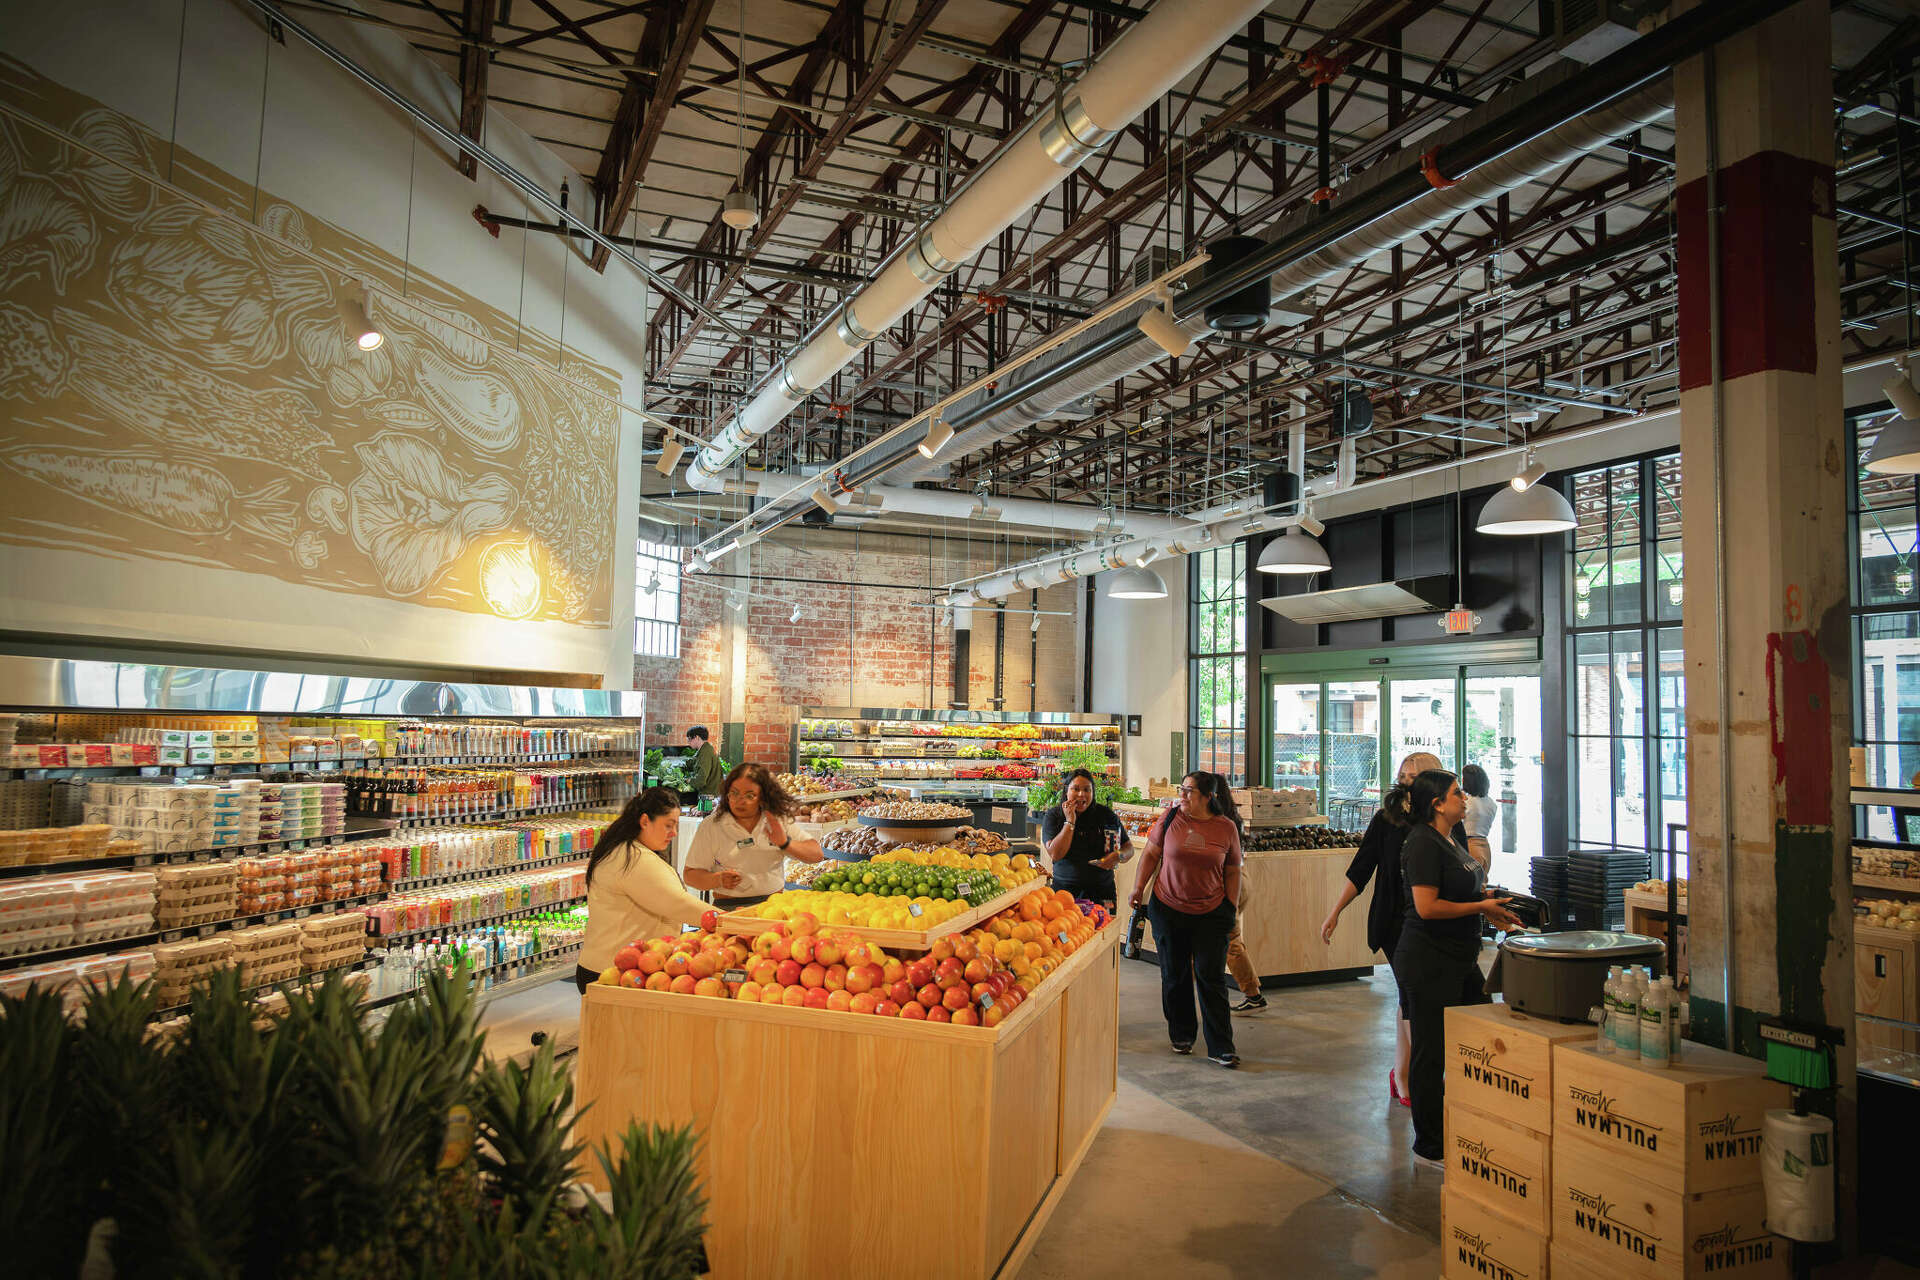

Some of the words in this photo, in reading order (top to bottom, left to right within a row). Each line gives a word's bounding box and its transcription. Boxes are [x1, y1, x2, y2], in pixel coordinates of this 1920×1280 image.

[1449, 612, 1471, 632] EXIT
[1464, 1063, 1529, 1099] PULLMAN
[1576, 1108, 1657, 1152] PULLMAN
[1705, 1136, 1763, 1160] ULLMAN
[1462, 1155, 1527, 1198] PULLMAN
[1576, 1210, 1656, 1261] PULLMAN
[1704, 1241, 1773, 1272] PULLMAN
